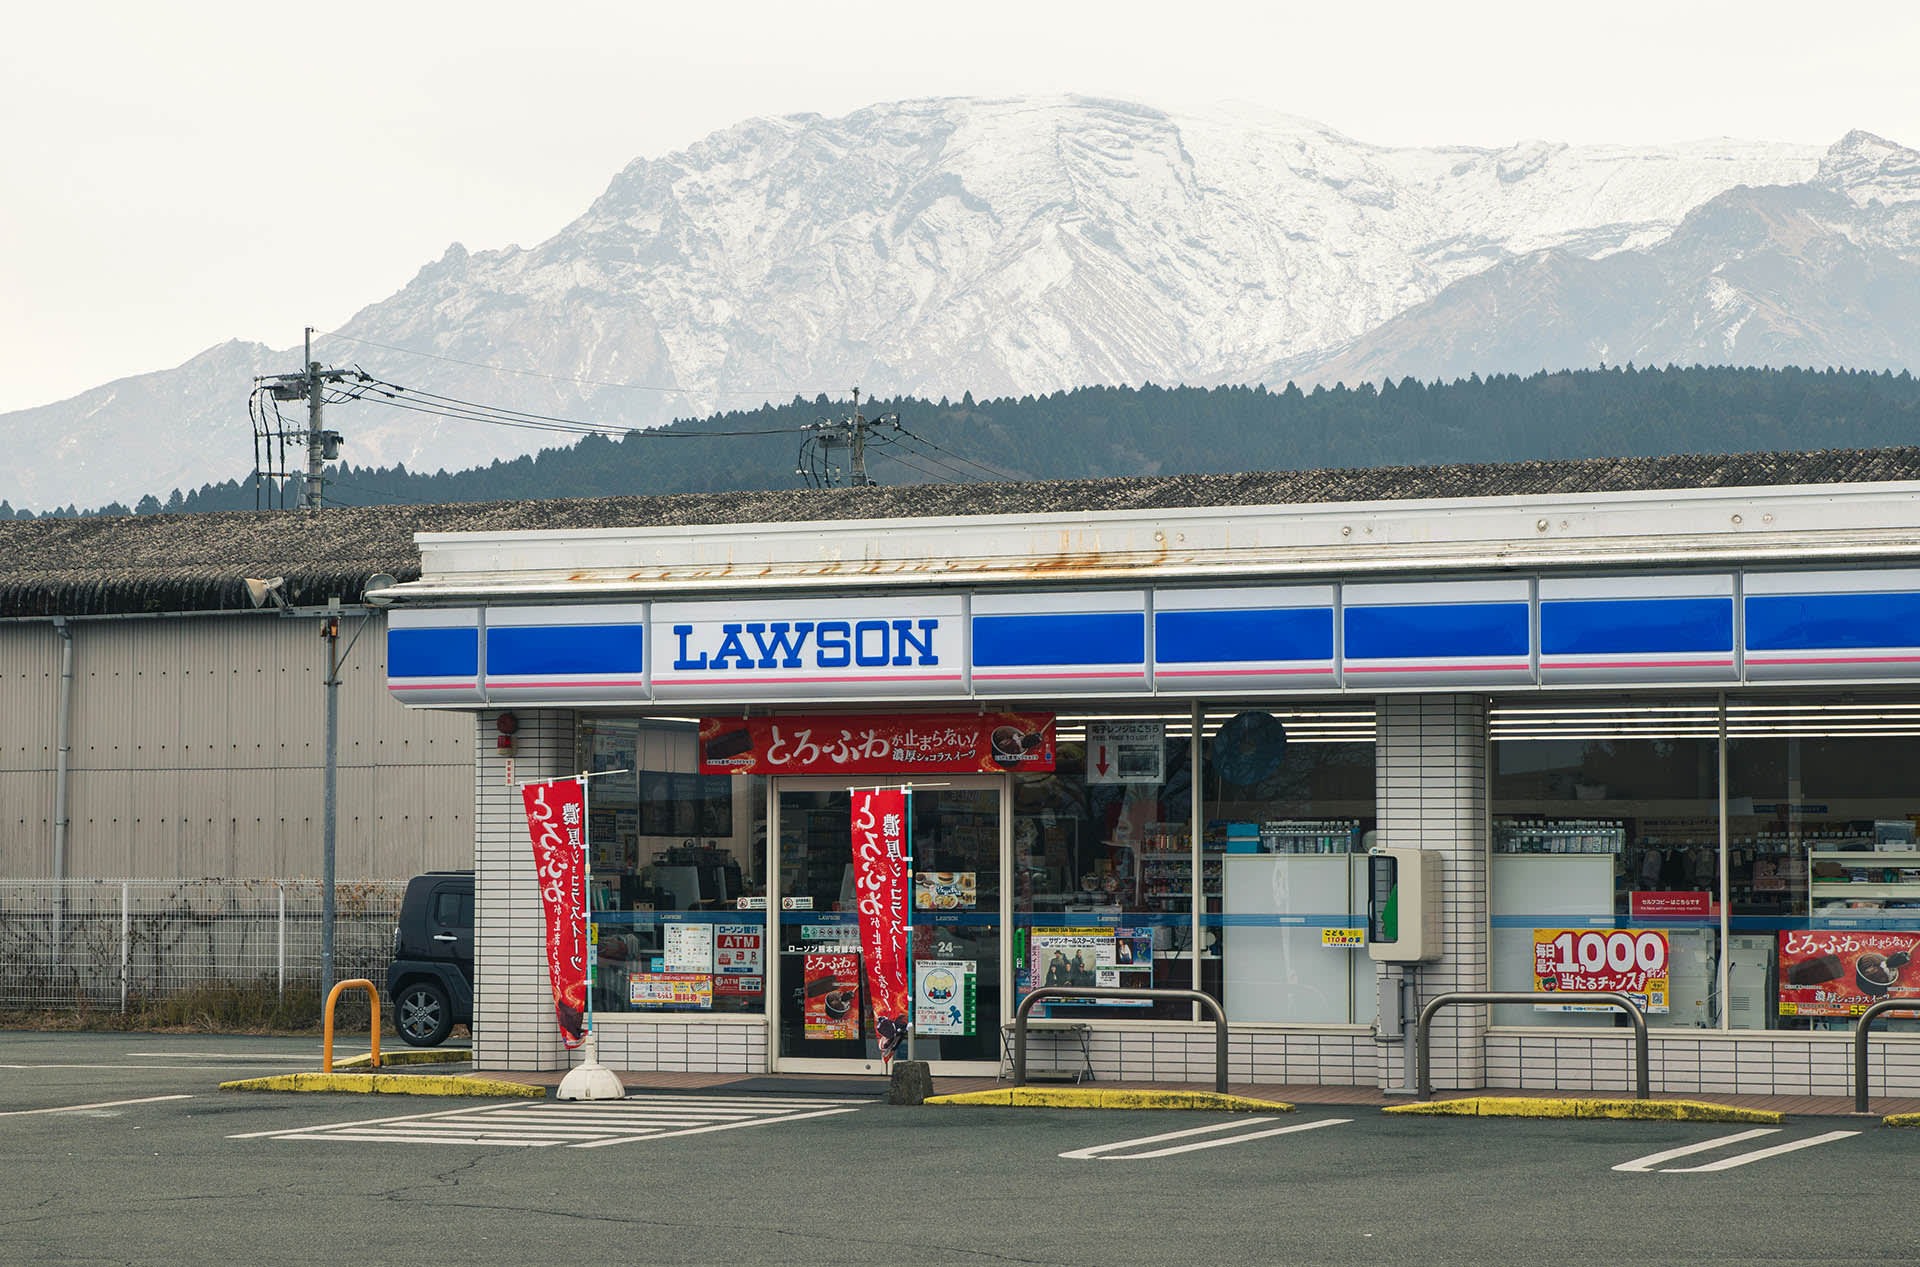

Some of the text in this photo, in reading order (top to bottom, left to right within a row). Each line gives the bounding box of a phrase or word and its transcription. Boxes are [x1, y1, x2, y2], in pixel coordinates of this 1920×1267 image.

[673, 619, 939, 671] LAWSON
[892, 748, 978, 763] 濃厚ショコラスイーツ
[719, 926, 758, 934] ローソン銀行
[1325, 929, 1345, 937] こども
[723, 936, 754, 948] ATM
[937, 941, 953, 953] 24
[1535, 943, 1555, 958] 毎日
[1554, 932, 1665, 974] 1,000
[1536, 958, 1556, 973] 最大
[1646, 968, 1667, 979] ポイント
